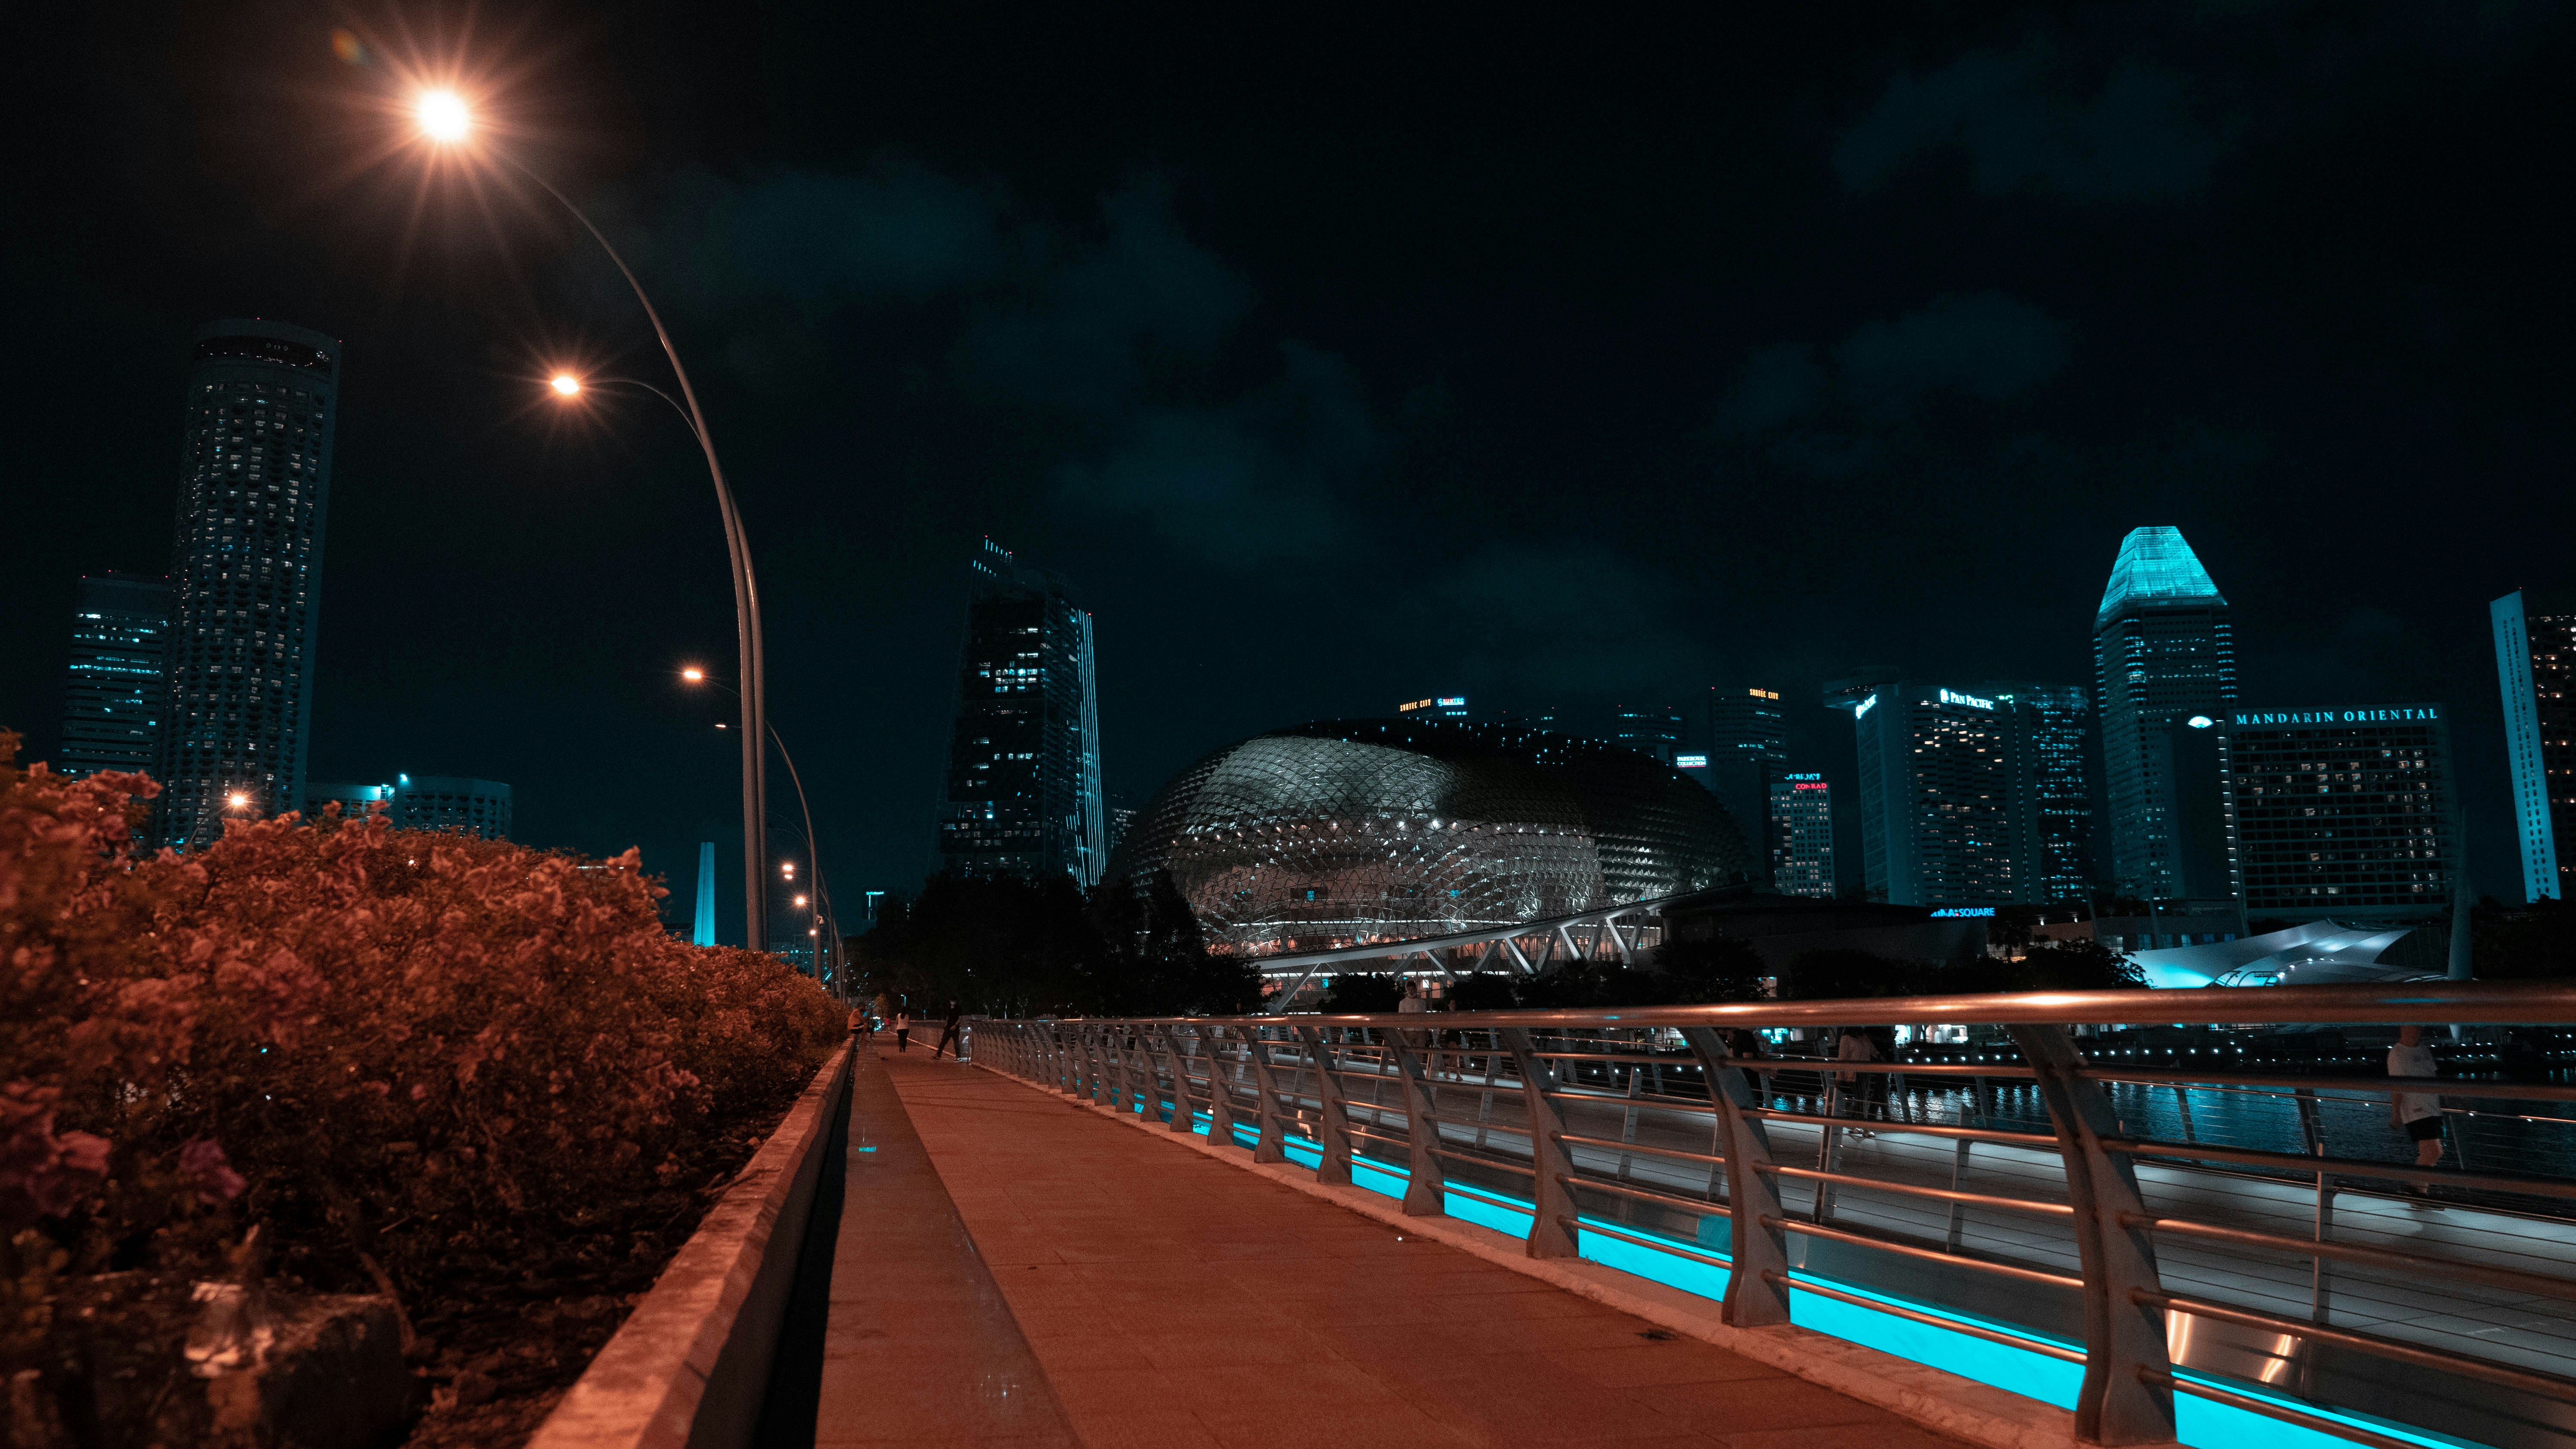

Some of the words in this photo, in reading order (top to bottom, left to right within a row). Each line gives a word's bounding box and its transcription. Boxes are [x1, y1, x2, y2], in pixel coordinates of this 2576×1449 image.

[1768, 691, 1778, 700] CITY
[1420, 699, 1431, 708] CITY
[1950, 692, 1965, 704] PAN
[1965, 695, 1994, 710] PACIFIC
[2236, 712, 2333, 724] MANDARIN
[2344, 709, 2437, 721] ORIENTAL
[1959, 908, 1995, 917] SQUARE
